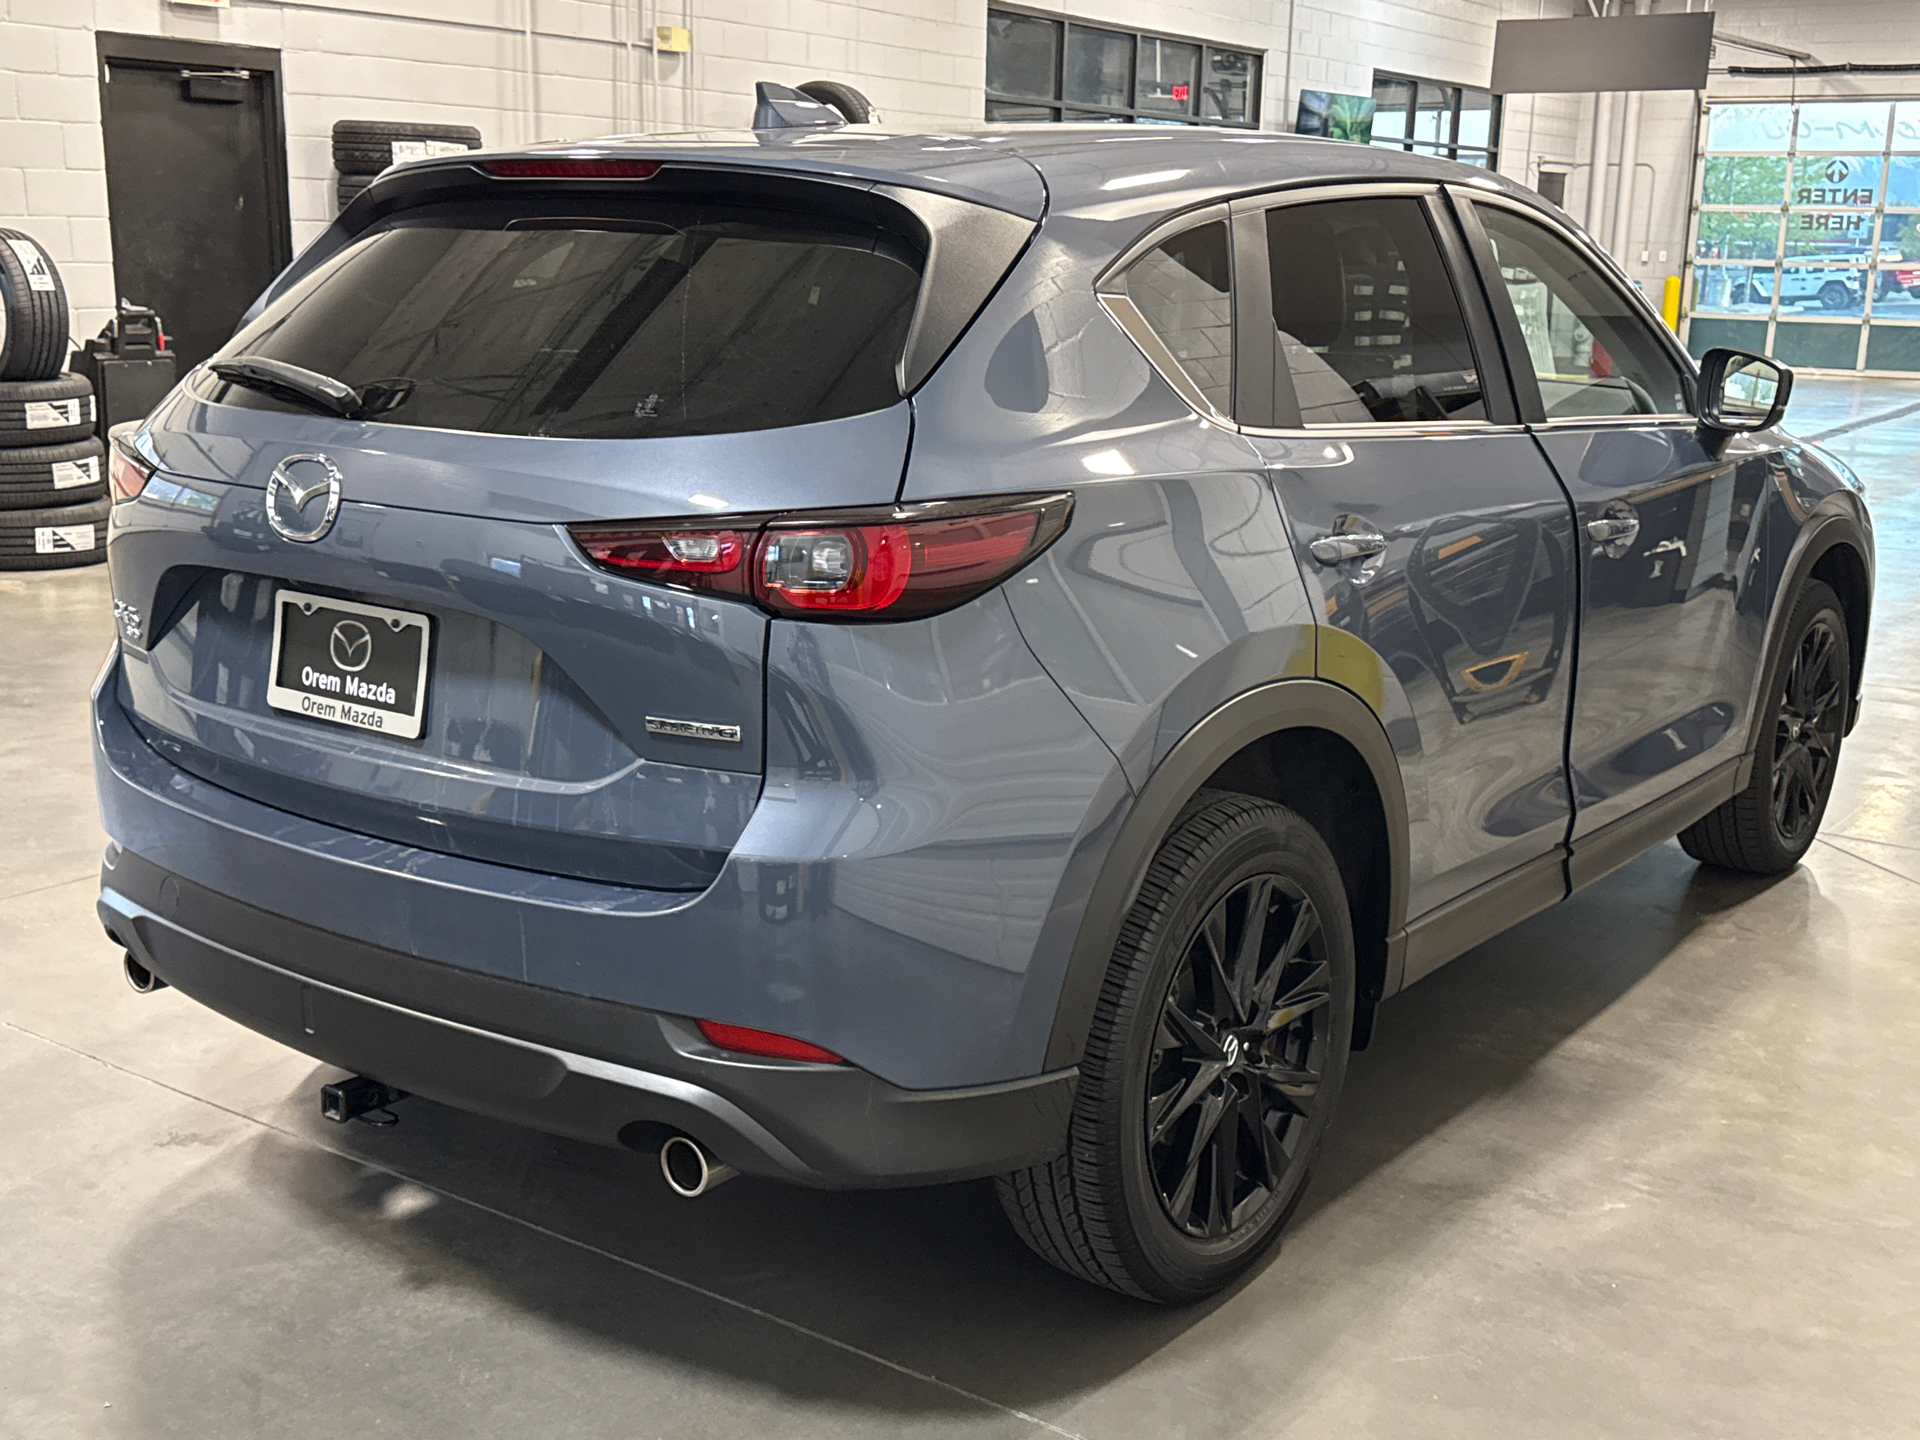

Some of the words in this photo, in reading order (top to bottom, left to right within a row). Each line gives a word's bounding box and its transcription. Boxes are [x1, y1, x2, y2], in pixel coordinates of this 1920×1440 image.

[301, 665, 341, 693] Orem
[344, 674, 396, 705] Mazda
[301, 695, 336, 718] Orem
[340, 704, 384, 729] Mazda
